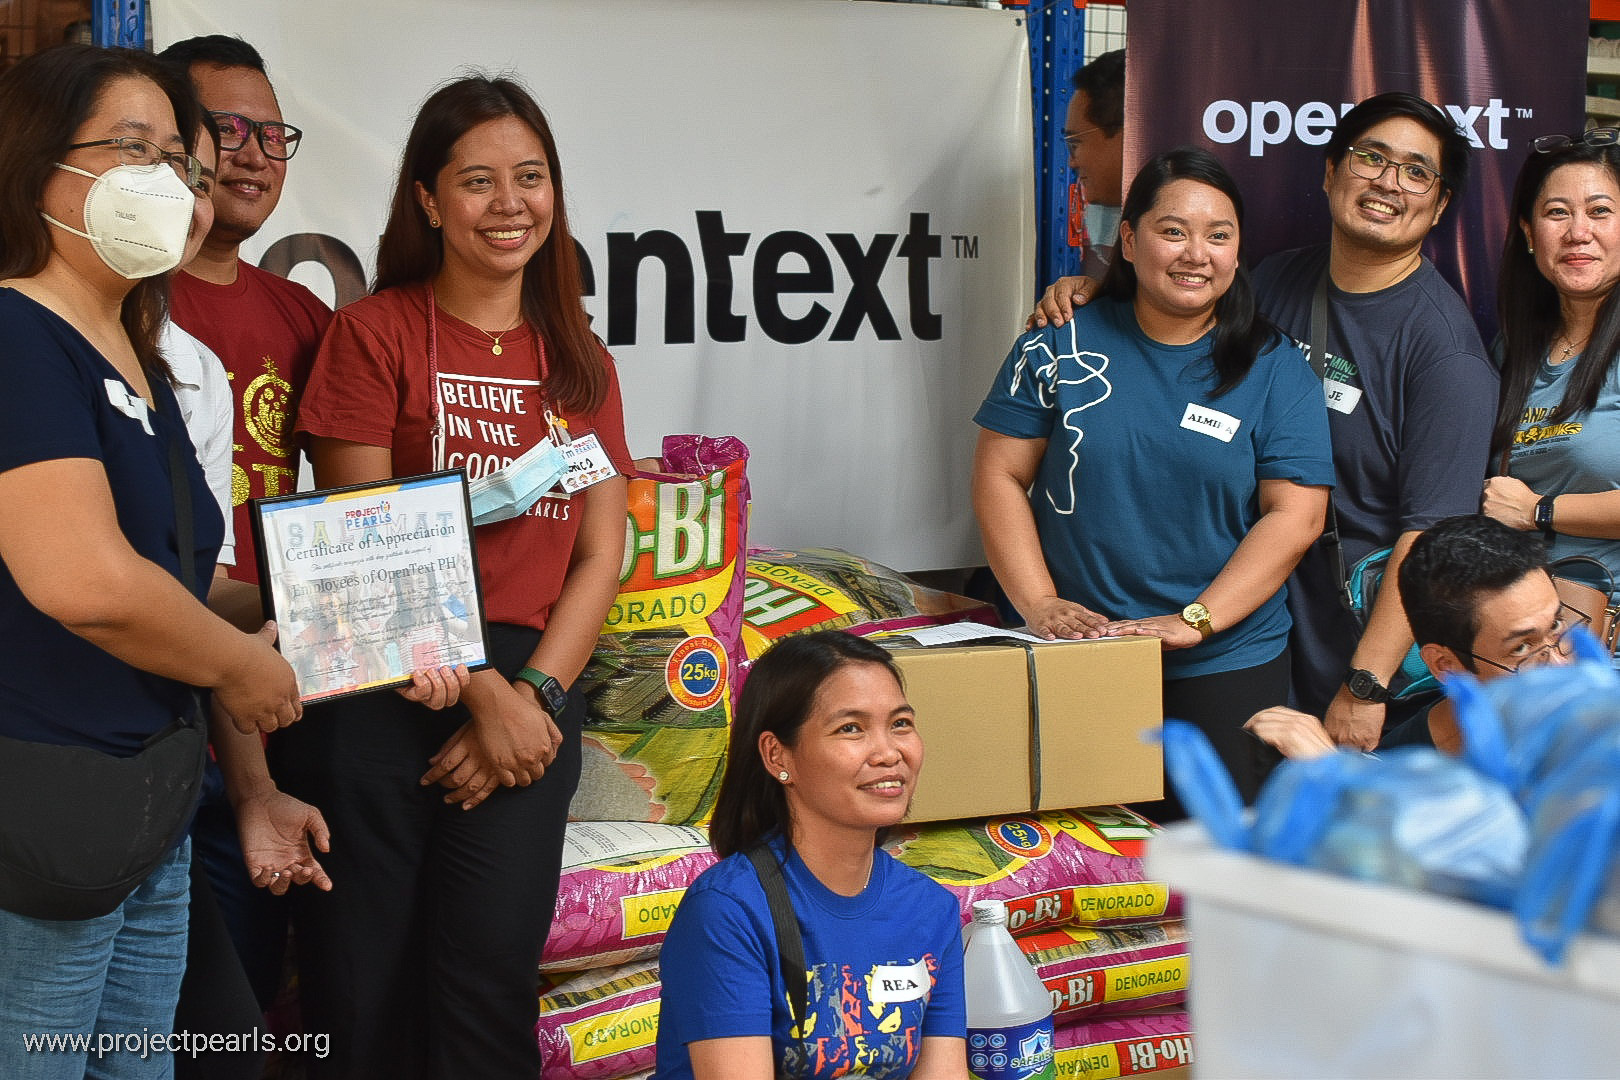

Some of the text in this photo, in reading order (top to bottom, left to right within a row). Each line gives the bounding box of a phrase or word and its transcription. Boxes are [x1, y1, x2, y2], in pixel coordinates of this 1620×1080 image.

[1202, 98, 1510, 157] opext
[258, 210, 943, 346] ontext
[1329, 355, 1358, 377] MIND
[442, 381, 527, 415] BELIEVE
[448, 413, 521, 447] IN THE
[345, 506, 381, 520] PROJECT
[346, 513, 393, 530] PEARLS
[617, 470, 726, 586] -Bi
[285, 523, 455, 562] Certificate of Appreciation
[292, 575, 360, 599] Eloyees
[363, 568, 376, 586] of
[378, 562, 435, 584] OpenText
[437, 556, 457, 571] PH
[683, 663, 718, 681] 25kg
[1005, 823, 1033, 849] 25kg
[1081, 893, 1155, 912] DENORADO
[882, 978, 919, 992] REA
[1115, 967, 1182, 992] DENORADO
[1127, 1037, 1194, 1071] Ho-Bi
